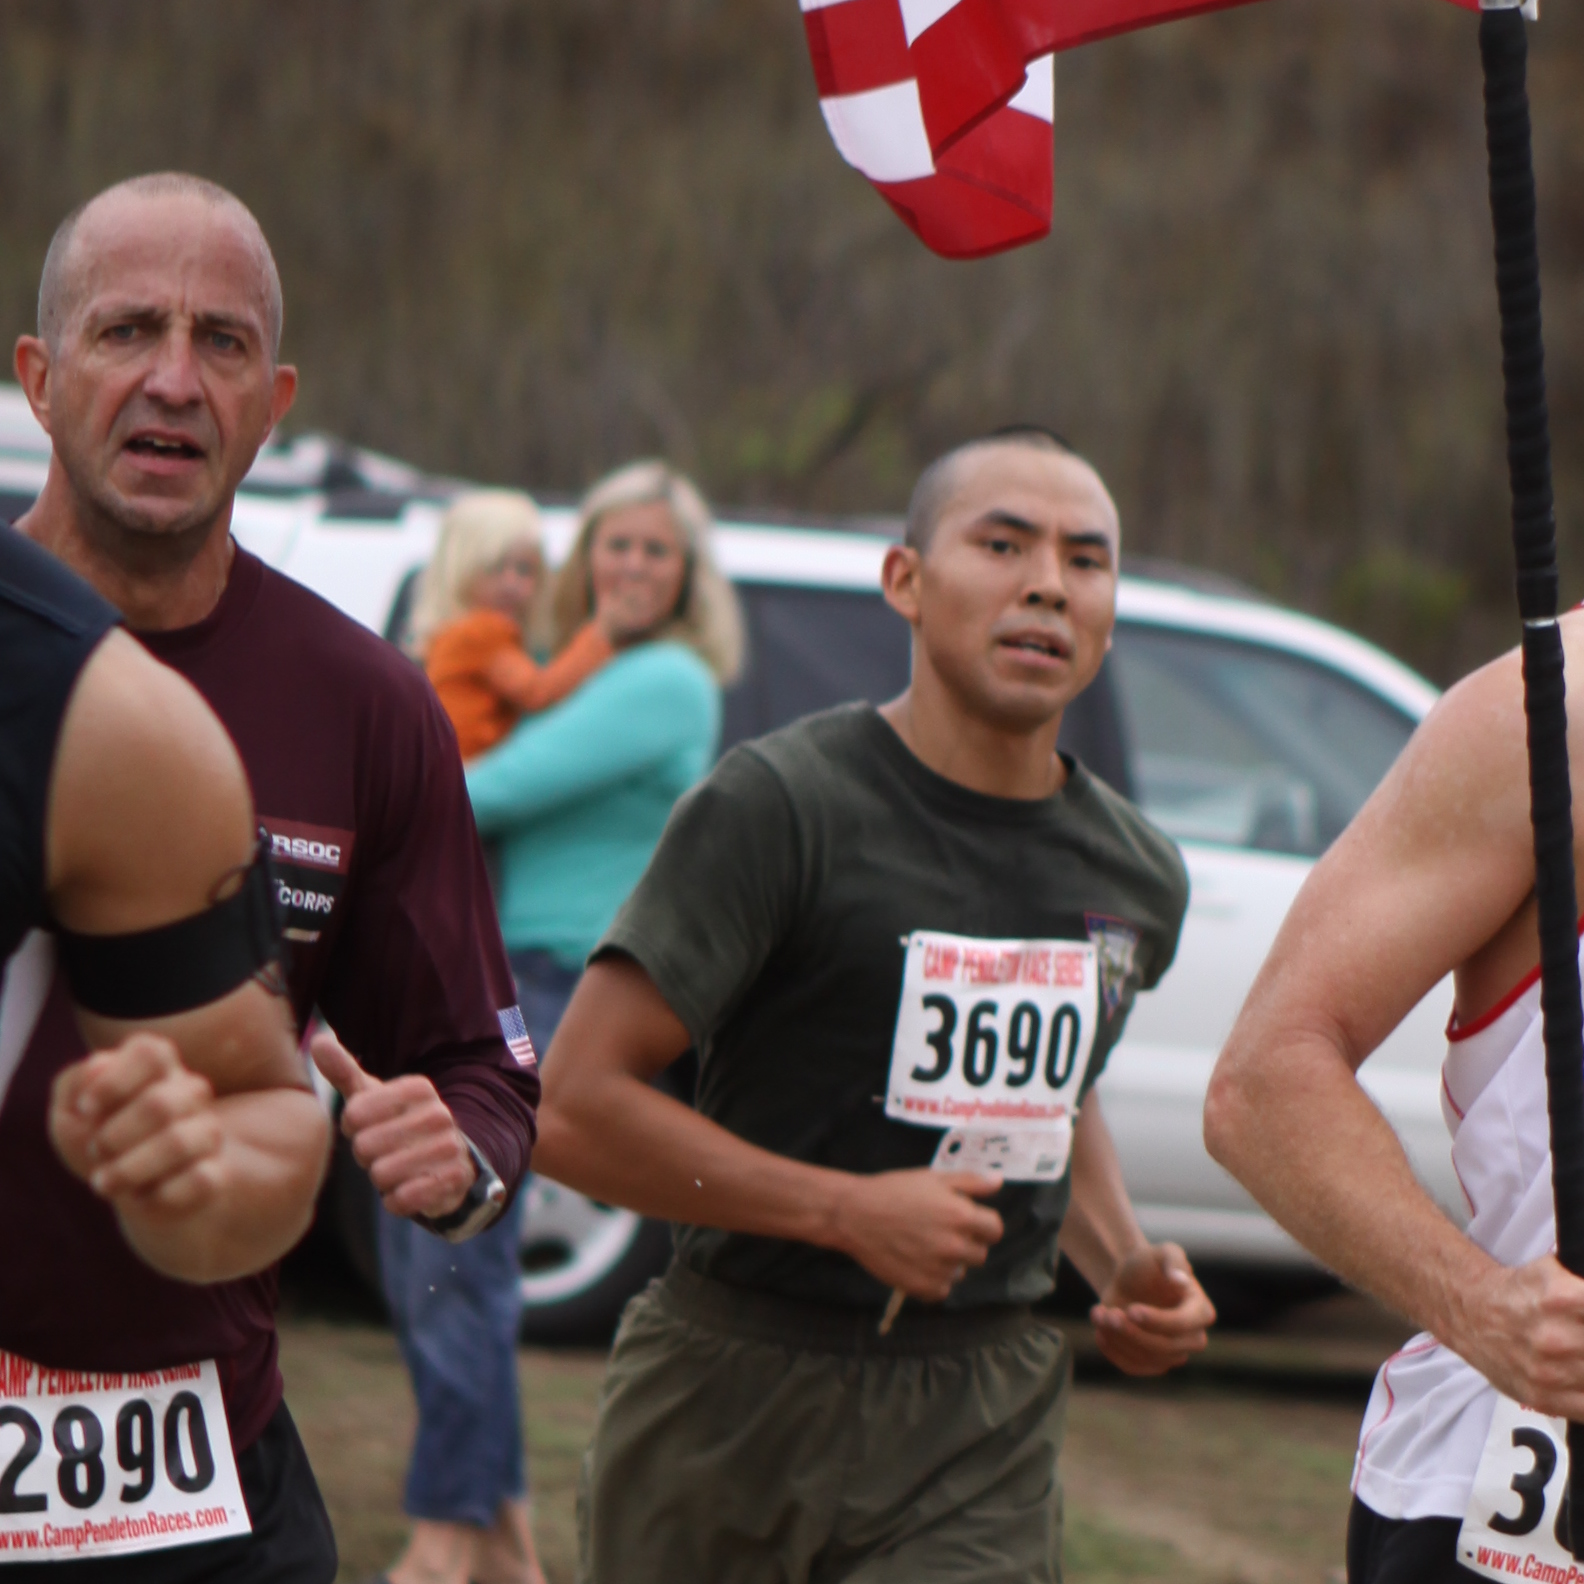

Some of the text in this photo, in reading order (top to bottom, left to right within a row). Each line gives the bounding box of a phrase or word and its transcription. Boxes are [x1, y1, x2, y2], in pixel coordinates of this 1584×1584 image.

[278, 886, 334, 914] CORPS
[911, 994, 1081, 1089] 3690
[0, 1349, 33, 1398] AMP
[0, 1390, 215, 1514] 2890
